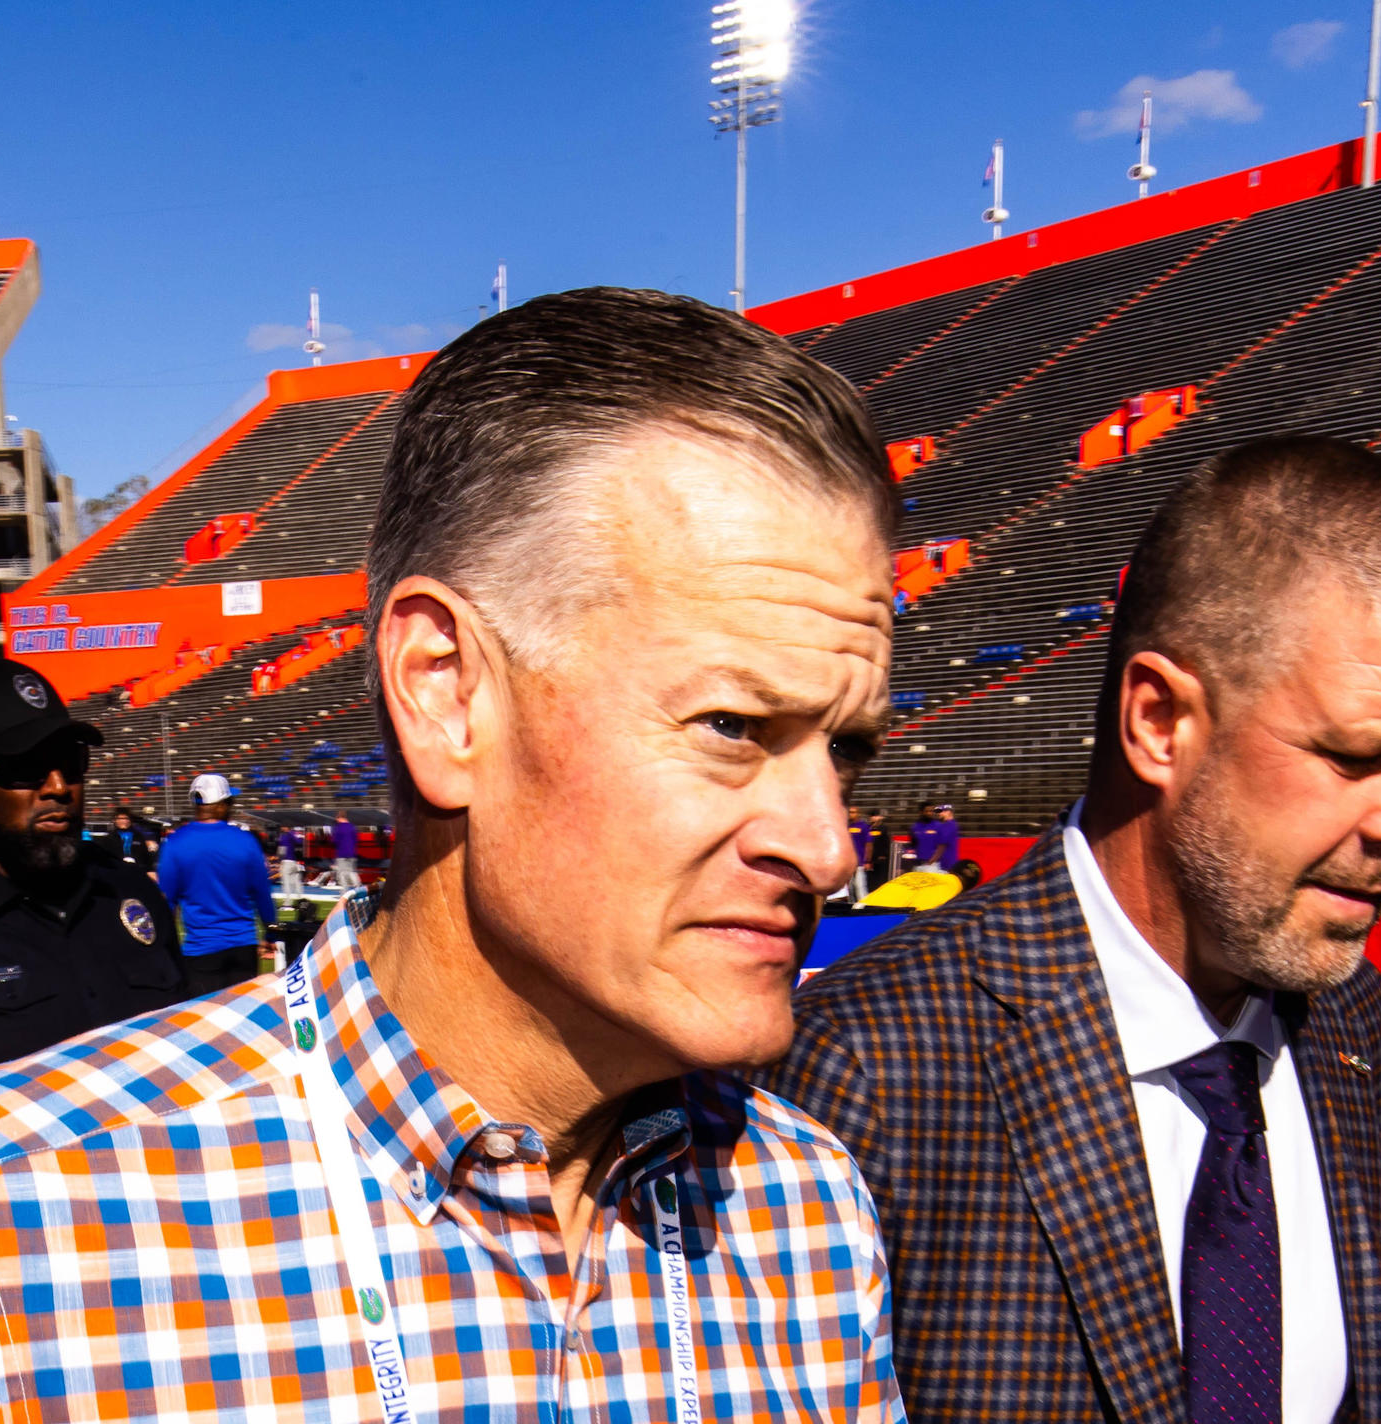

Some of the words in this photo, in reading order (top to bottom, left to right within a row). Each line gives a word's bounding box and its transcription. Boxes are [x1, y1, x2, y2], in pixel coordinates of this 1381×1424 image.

[12, 628, 69, 653] GATOR
[73, 622, 162, 650] COUNTRY
[289, 993, 309, 1008] A
[661, 1223, 680, 1236] A
[663, 1240, 693, 1371] CHAMPIONSHIP
